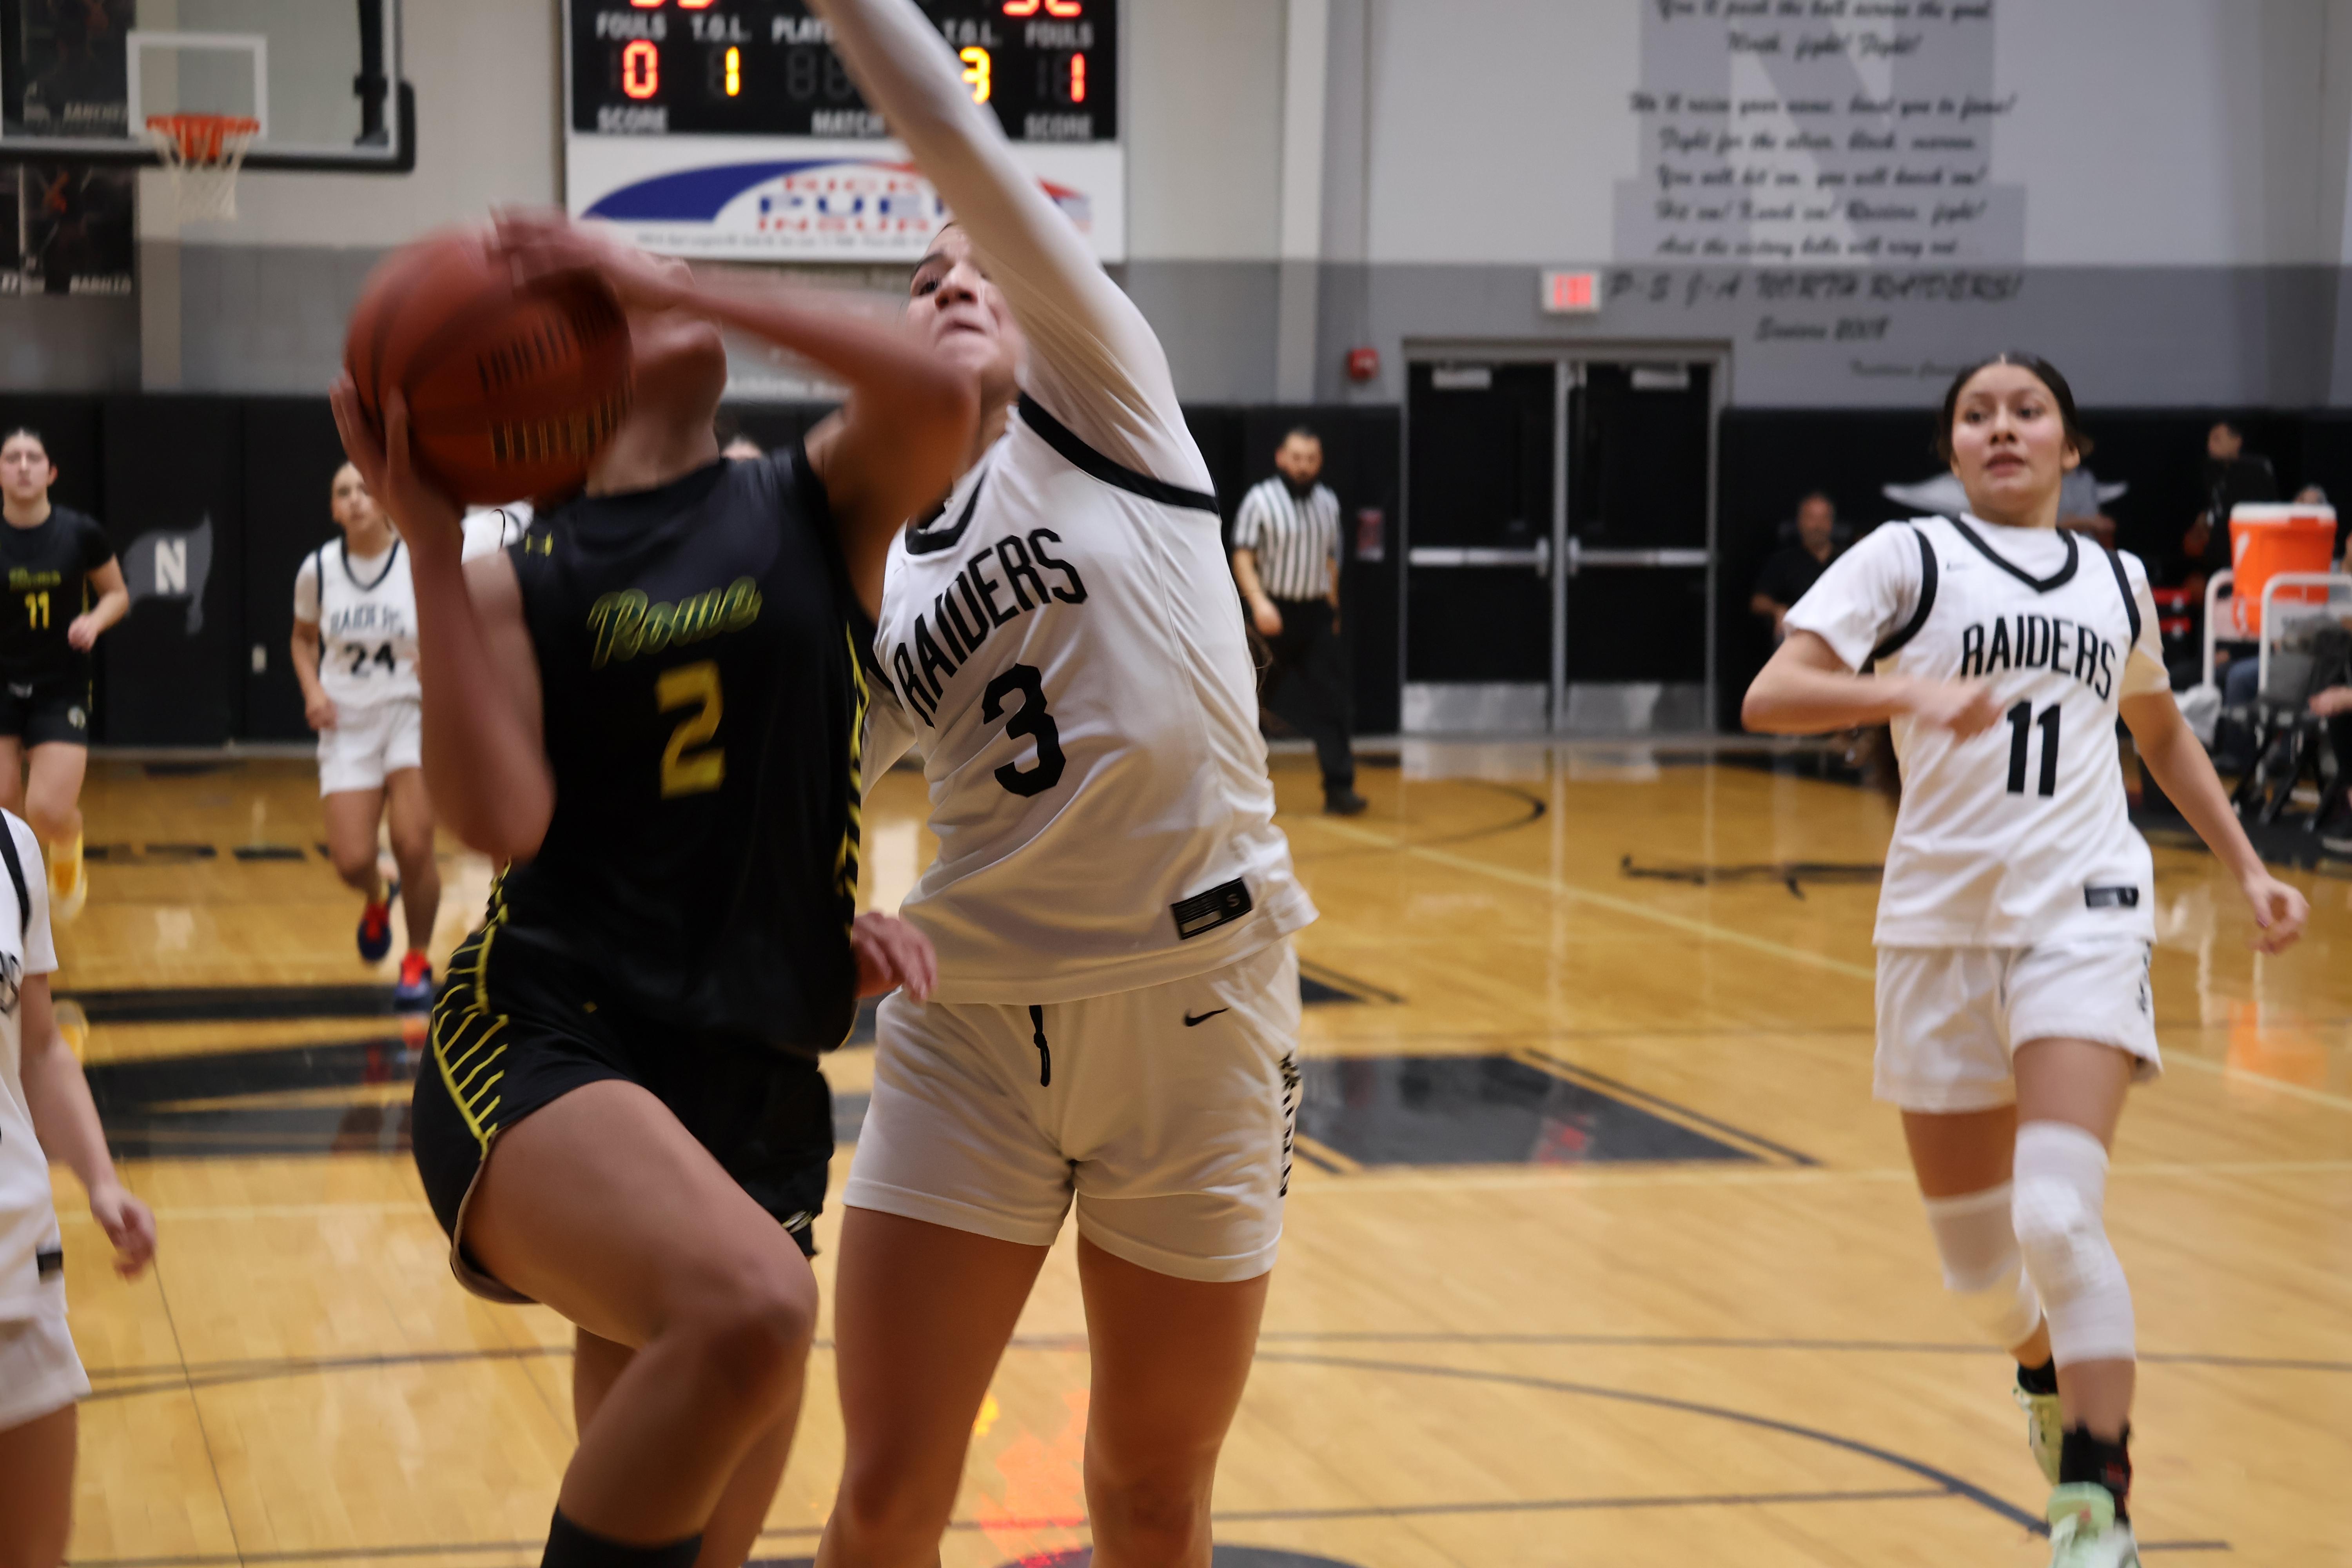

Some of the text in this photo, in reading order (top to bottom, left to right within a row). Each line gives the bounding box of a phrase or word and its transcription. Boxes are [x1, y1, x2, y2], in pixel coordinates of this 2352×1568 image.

[595, 11, 667, 41] FOULS
[1023, 20, 1094, 50] FOULS
[622, 38, 1086, 105] 0 1 3 1
[155, 536, 187, 594] N
[24, 591, 50, 631] 11
[894, 527, 1088, 730] RAIDERS
[341, 640, 396, 680] 24
[1961, 613, 2116, 703] RAIDERS
[653, 657, 728, 800] 2
[981, 662, 1066, 798] 3
[2006, 700, 2062, 797] 11
